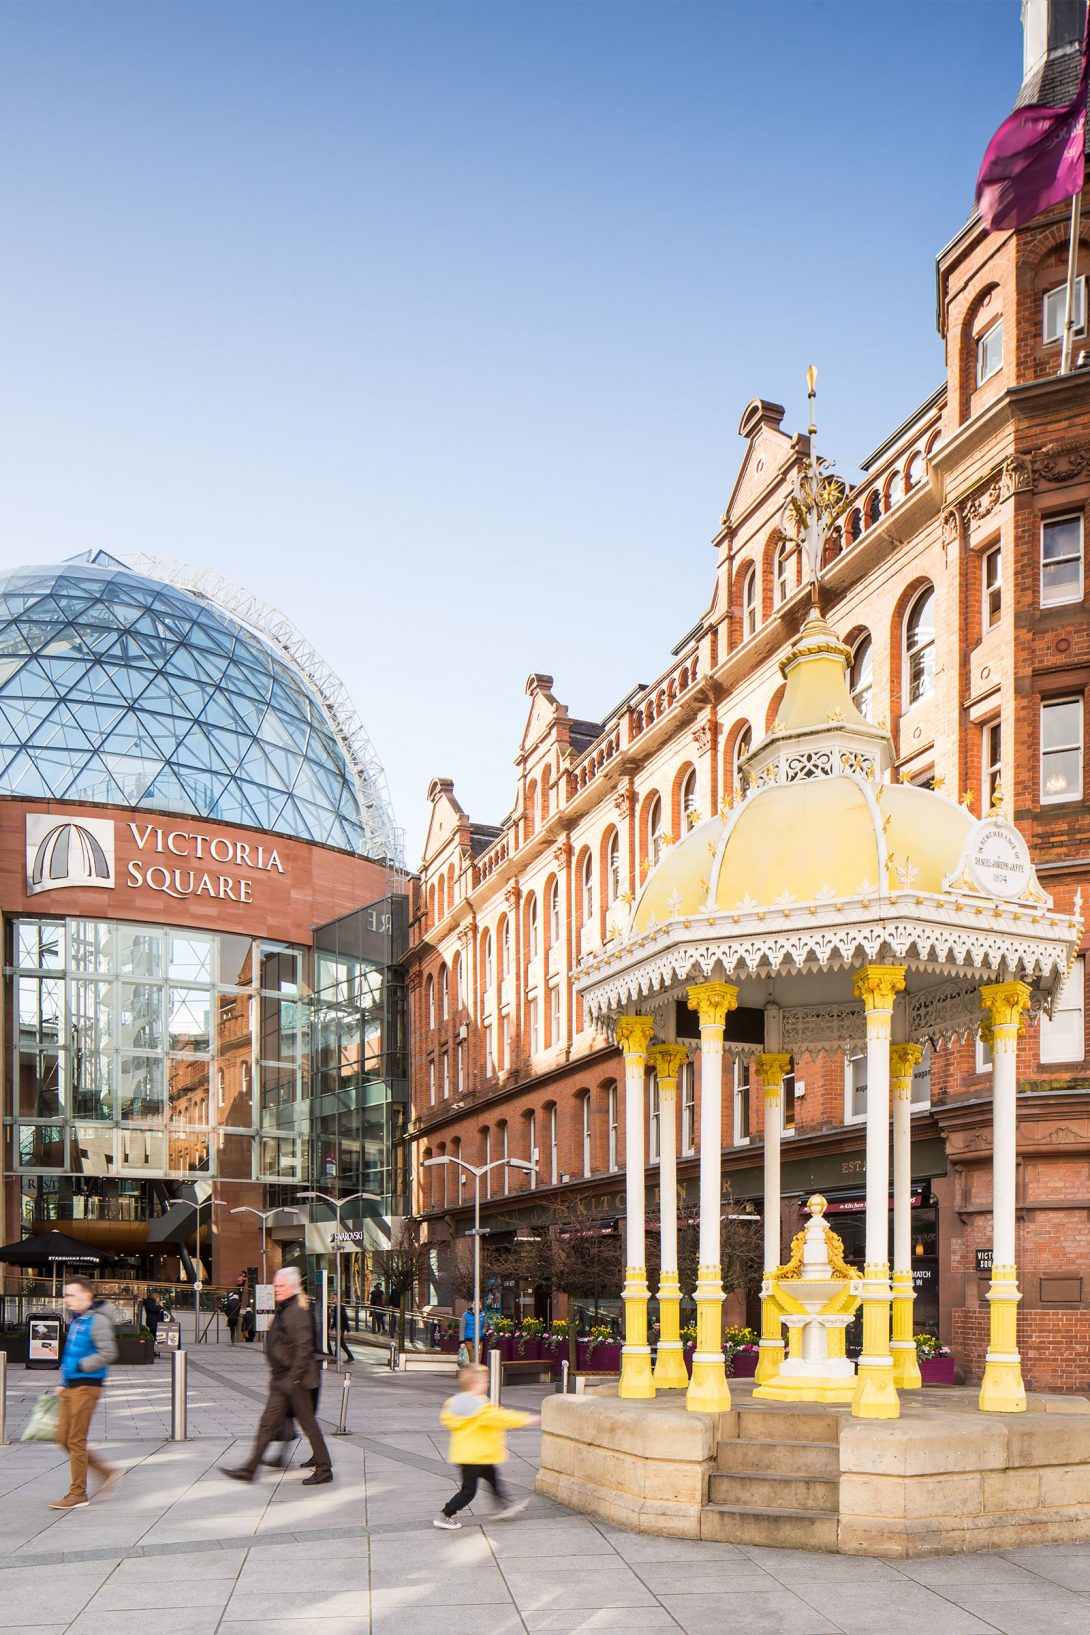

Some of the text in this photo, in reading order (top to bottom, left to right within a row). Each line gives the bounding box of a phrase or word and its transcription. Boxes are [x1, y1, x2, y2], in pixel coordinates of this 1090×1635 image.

[127, 822, 285, 874] VICTORIA
[127, 861, 253, 904] SQUARE
[977, 1251, 992, 1260] VICT
[980, 1260, 992, 1268] SQU
